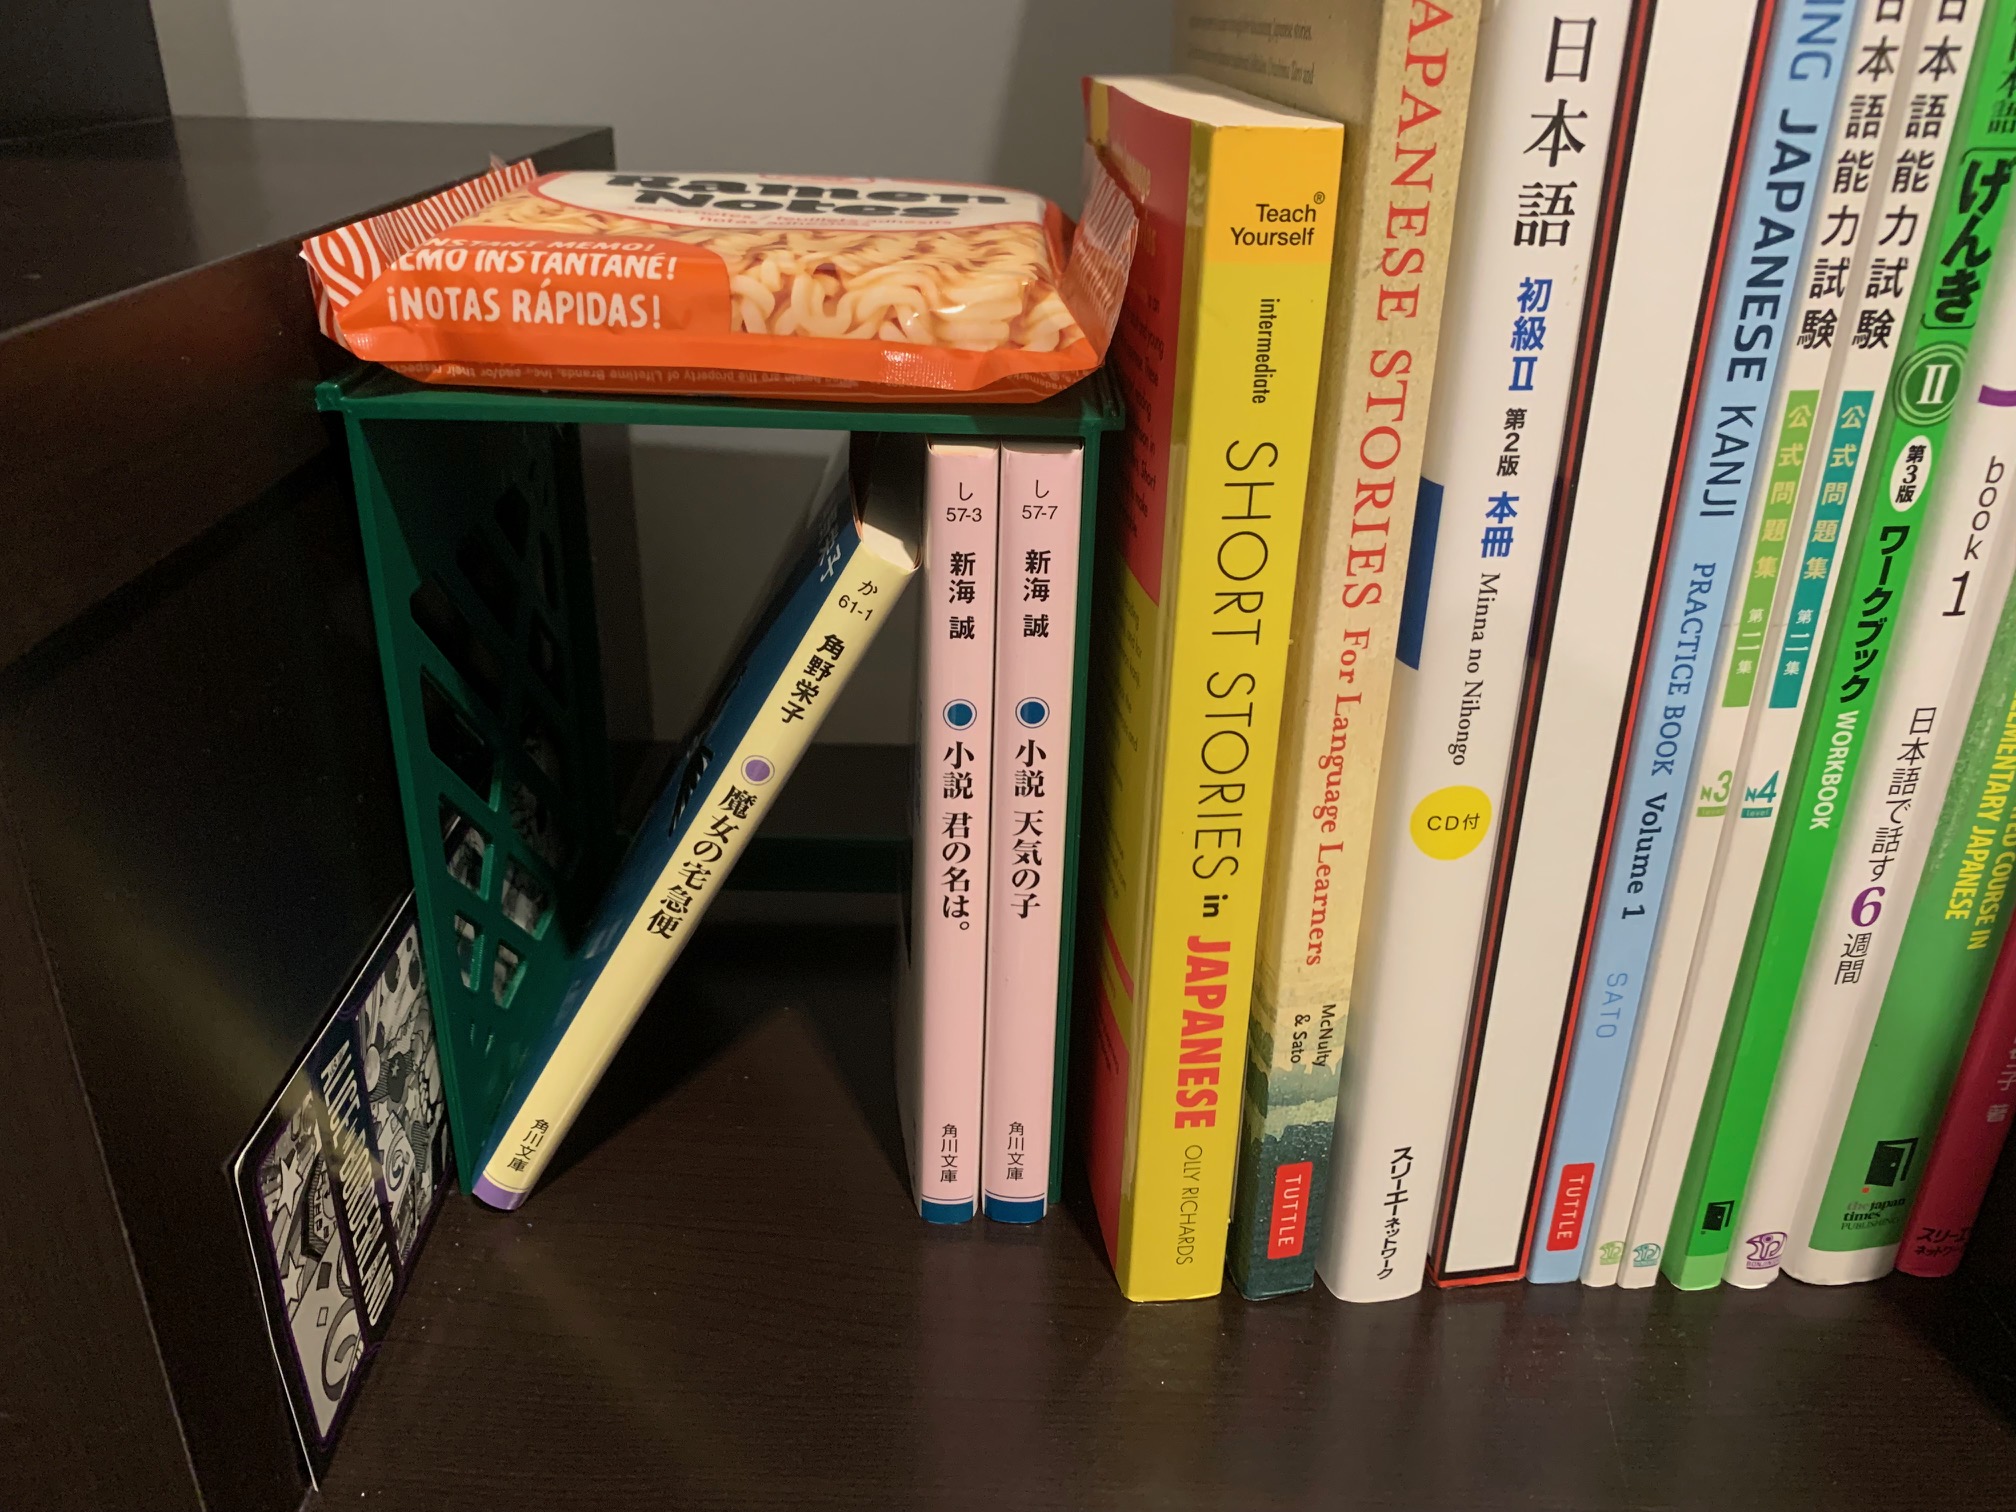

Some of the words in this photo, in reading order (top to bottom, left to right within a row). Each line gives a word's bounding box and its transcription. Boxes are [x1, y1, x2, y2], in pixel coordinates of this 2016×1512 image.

[1513, 15, 1597, 247] 日本語
[606, 174, 1009, 204] Ramen
[634, 189, 962, 217] Notes
[424, 238, 536, 249] NSTANT
[546, 240, 656, 251] MEMO!
[473, 249, 678, 280] INSTANTANÉ!
[1231, 227, 1316, 246] Yourself
[1726, 108, 1818, 382] JAPANESE
[1935, 158, 2016, 323] げんき
[386, 285, 500, 322] ¡NOTAS
[512, 278, 662, 329] RÁPIDAS!
[1251, 298, 1281, 405] intermediate
[1496, 407, 1528, 477] 第2版
[1699, 406, 1757, 516] KANJI
[1895, 445, 1925, 503] 第3版
[959, 482, 974, 500] し
[1035, 479, 1050, 499] し
[1343, 349, 1413, 608] STORIES
[1754, 404, 1812, 580] 公式問題集
[1803, 404, 1866, 580] 公式問題集
[1964, 455, 2005, 560] book
[946, 507, 983, 523] 57-3
[1021, 505, 1059, 521] 57-7
[1212, 440, 1279, 645] SHORT
[1480, 491, 1520, 559] 本冊
[837, 594, 874, 621] 61-1
[858, 579, 879, 597] か
[1472, 572, 1501, 642] Minna
[1839, 525, 1911, 703] ワークブック
[1942, 571, 1970, 617] 1
[1339, 627, 1372, 684] For
[1466, 648, 1484, 673] no
[1667, 563, 1716, 695] PRACTICE
[1736, 607, 1765, 675] 第二集
[1783, 608, 1814, 676] 第二集
[780, 633, 846, 725] 角野栄子
[1447, 680, 1484, 766] Nihongo
[1651, 705, 1686, 777] BOOK
[1192, 671, 1256, 879] STORIES
[1312, 692, 1363, 833] Language
[1700, 769, 1733, 802] N3
[1744, 770, 1779, 803] N4
[1810, 710, 1859, 830] WORKBOOK
[1427, 812, 1480, 832] CD付
[1627, 792, 1668, 894] Volume
[646, 786, 758, 941] 魔女の宅急便
[1944, 825, 1997, 920] JAPANESE
[1974, 852, 2016, 926] COURSE
[1202, 894, 1229, 918] in
[1306, 841, 1345, 966] Learners
[1622, 904, 1646, 920] 1
[1967, 935, 1992, 950] IN
[1174, 935, 1232, 1129] JAPANESE
[1294, 1013, 1311, 1027] &
[1311, 1003, 1337, 1067] McNulty
[1596, 973, 1628, 1039] SATO
[1290, 1032, 1308, 1063] Sato
[320, 1039, 362, 1150] ALICE
[506, 1118, 550, 1175] 角川文庫
[940, 1123, 959, 1184] 角川文庫
[1006, 1121, 1025, 1182] 角川文庫
[1182, 1144, 1204, 1181] OLLY
[339, 1127, 395, 1327] BORDERLAND
[1175, 1187, 1200, 1265] RICHARDS
[1277, 1174, 1303, 1247] TUTTLE
[1376, 1146, 1414, 1280] スリーエーネットワーク
[1557, 1175, 1585, 1240] TUTTLE
[1843, 1211, 1881, 1222] times
